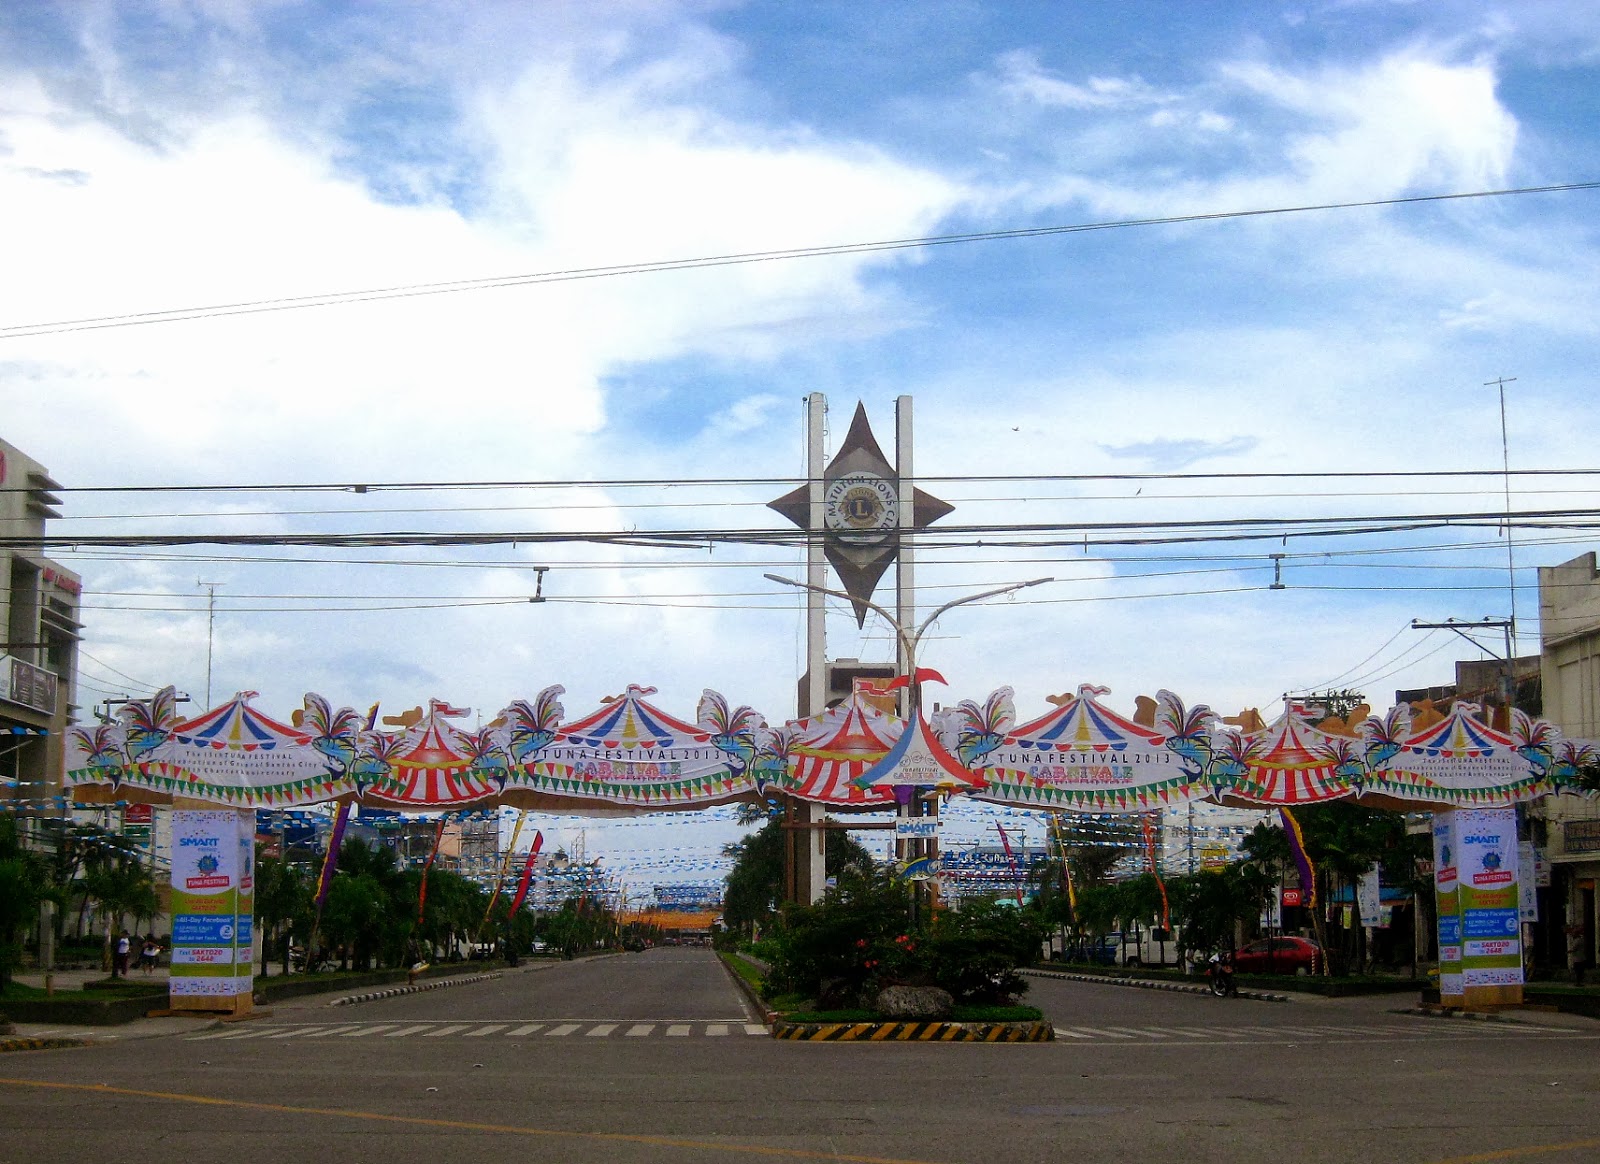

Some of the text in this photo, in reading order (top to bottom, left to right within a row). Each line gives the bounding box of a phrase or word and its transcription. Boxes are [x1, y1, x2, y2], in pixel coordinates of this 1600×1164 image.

[869, 479, 895, 506] LIONS
[881, 510, 896, 530] CLU
[225, 752, 245, 760] TUNA
[542, 750, 721, 760] TUNA FESTIVAL 2013
[998, 753, 1170, 764] TUNA FESTIVAL 2013
[574, 762, 681, 775] CARNIVALE
[1030, 766, 1133, 779] CARNIVALE
[898, 823, 937, 833] SMART
[180, 838, 219, 846] SMART
[1464, 835, 1501, 844] SMART
[203, 877, 229, 885] FESTIVAL
[1488, 873, 1511, 881] FESTIVAL
